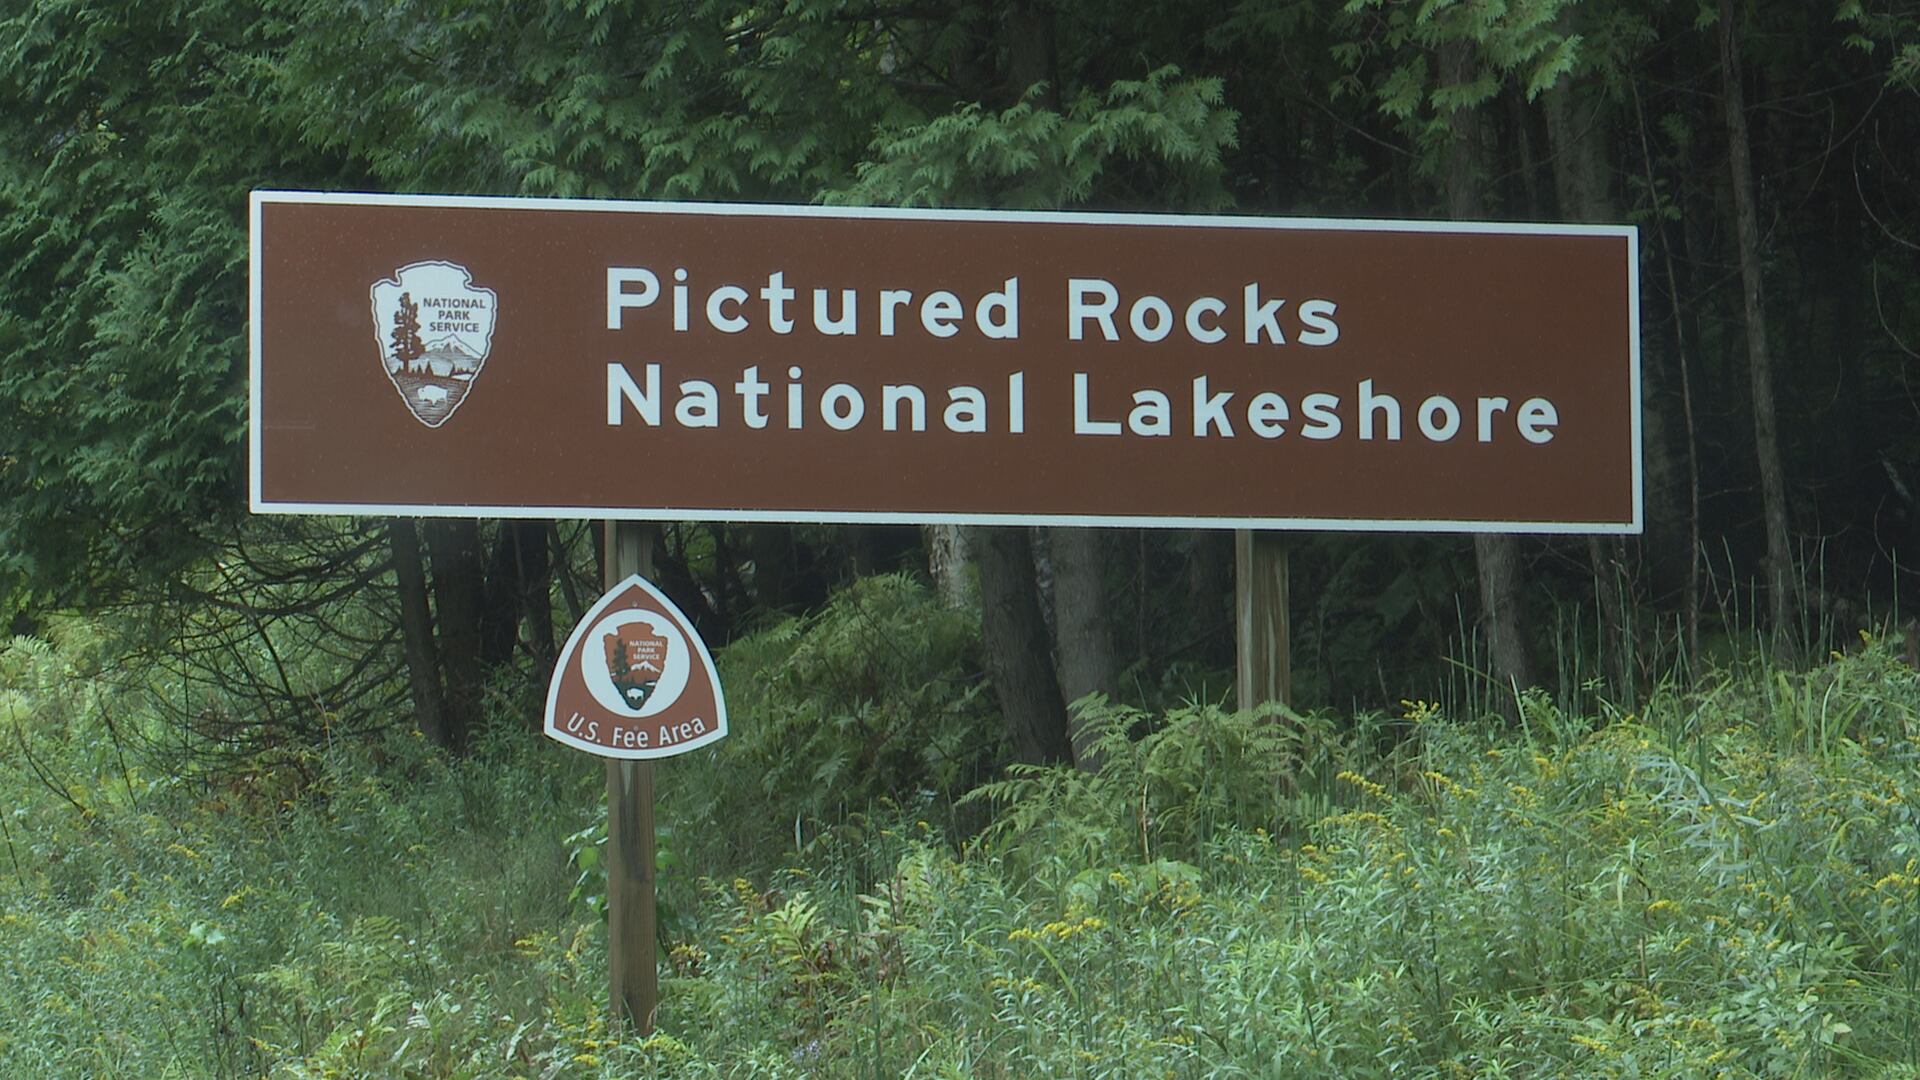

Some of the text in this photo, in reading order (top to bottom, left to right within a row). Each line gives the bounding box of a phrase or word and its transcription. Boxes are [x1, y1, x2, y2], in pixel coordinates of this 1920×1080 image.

[423, 298, 487, 309] NATIONAL
[607, 268, 1340, 346] Pictured Rocks
[438, 310, 471, 321] PARK
[429, 322, 480, 333] SERVICE
[606, 362, 1558, 444] National Lakeshore
[567, 712, 705, 748] U.S. Fee Area
